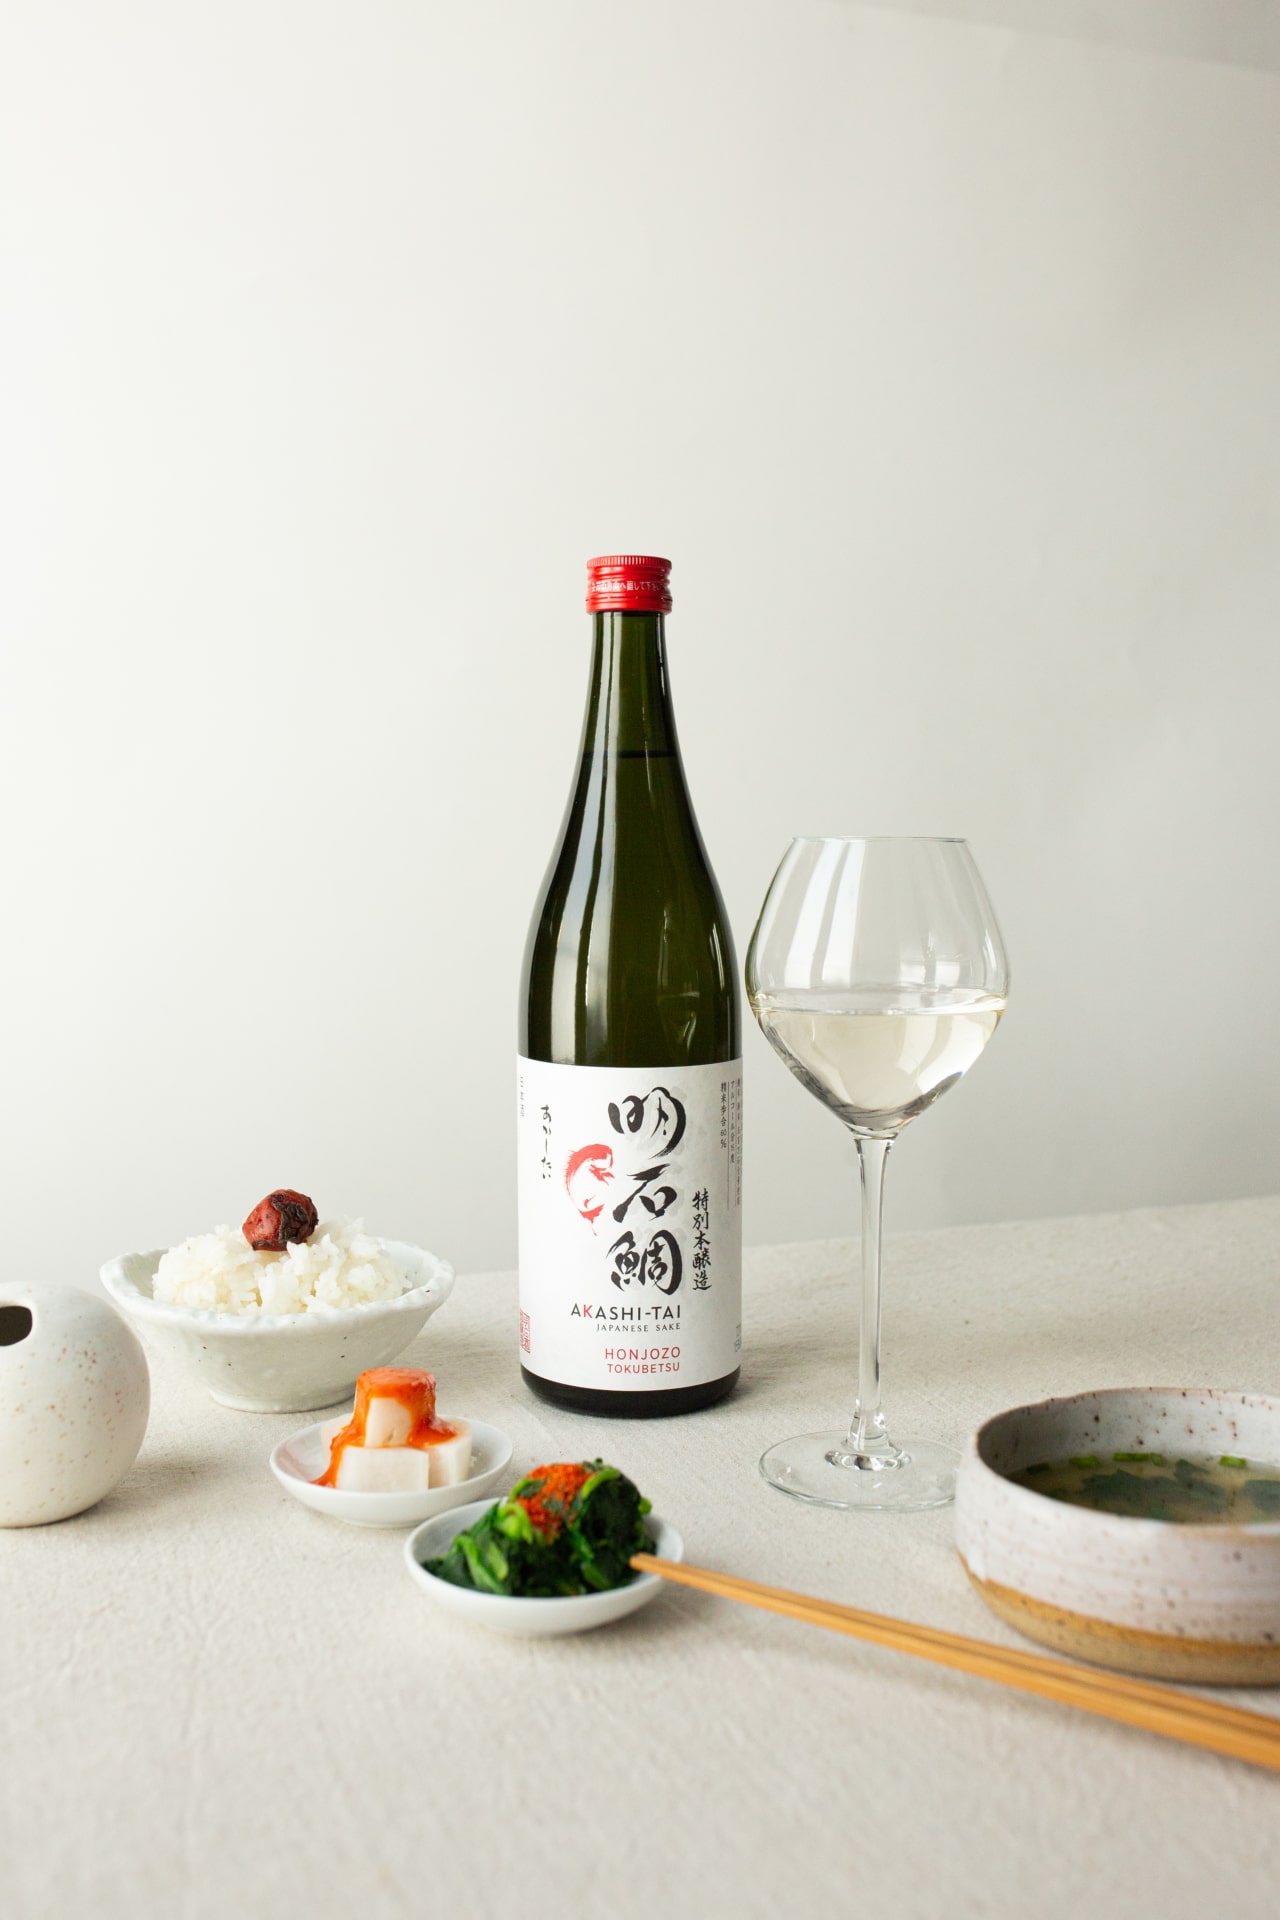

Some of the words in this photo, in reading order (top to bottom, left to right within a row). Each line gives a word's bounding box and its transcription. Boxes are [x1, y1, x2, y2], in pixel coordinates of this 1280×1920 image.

[692, 1187, 713, 1291] 特別本醸造
[570, 1303, 681, 1320] AKASHI-TAI
[597, 1323, 649, 1333] JAPANESE
[655, 1322, 681, 1332] SAKE
[605, 1346, 681, 1361] HONJOZO
[607, 1362, 680, 1374] TOKUBETSU
